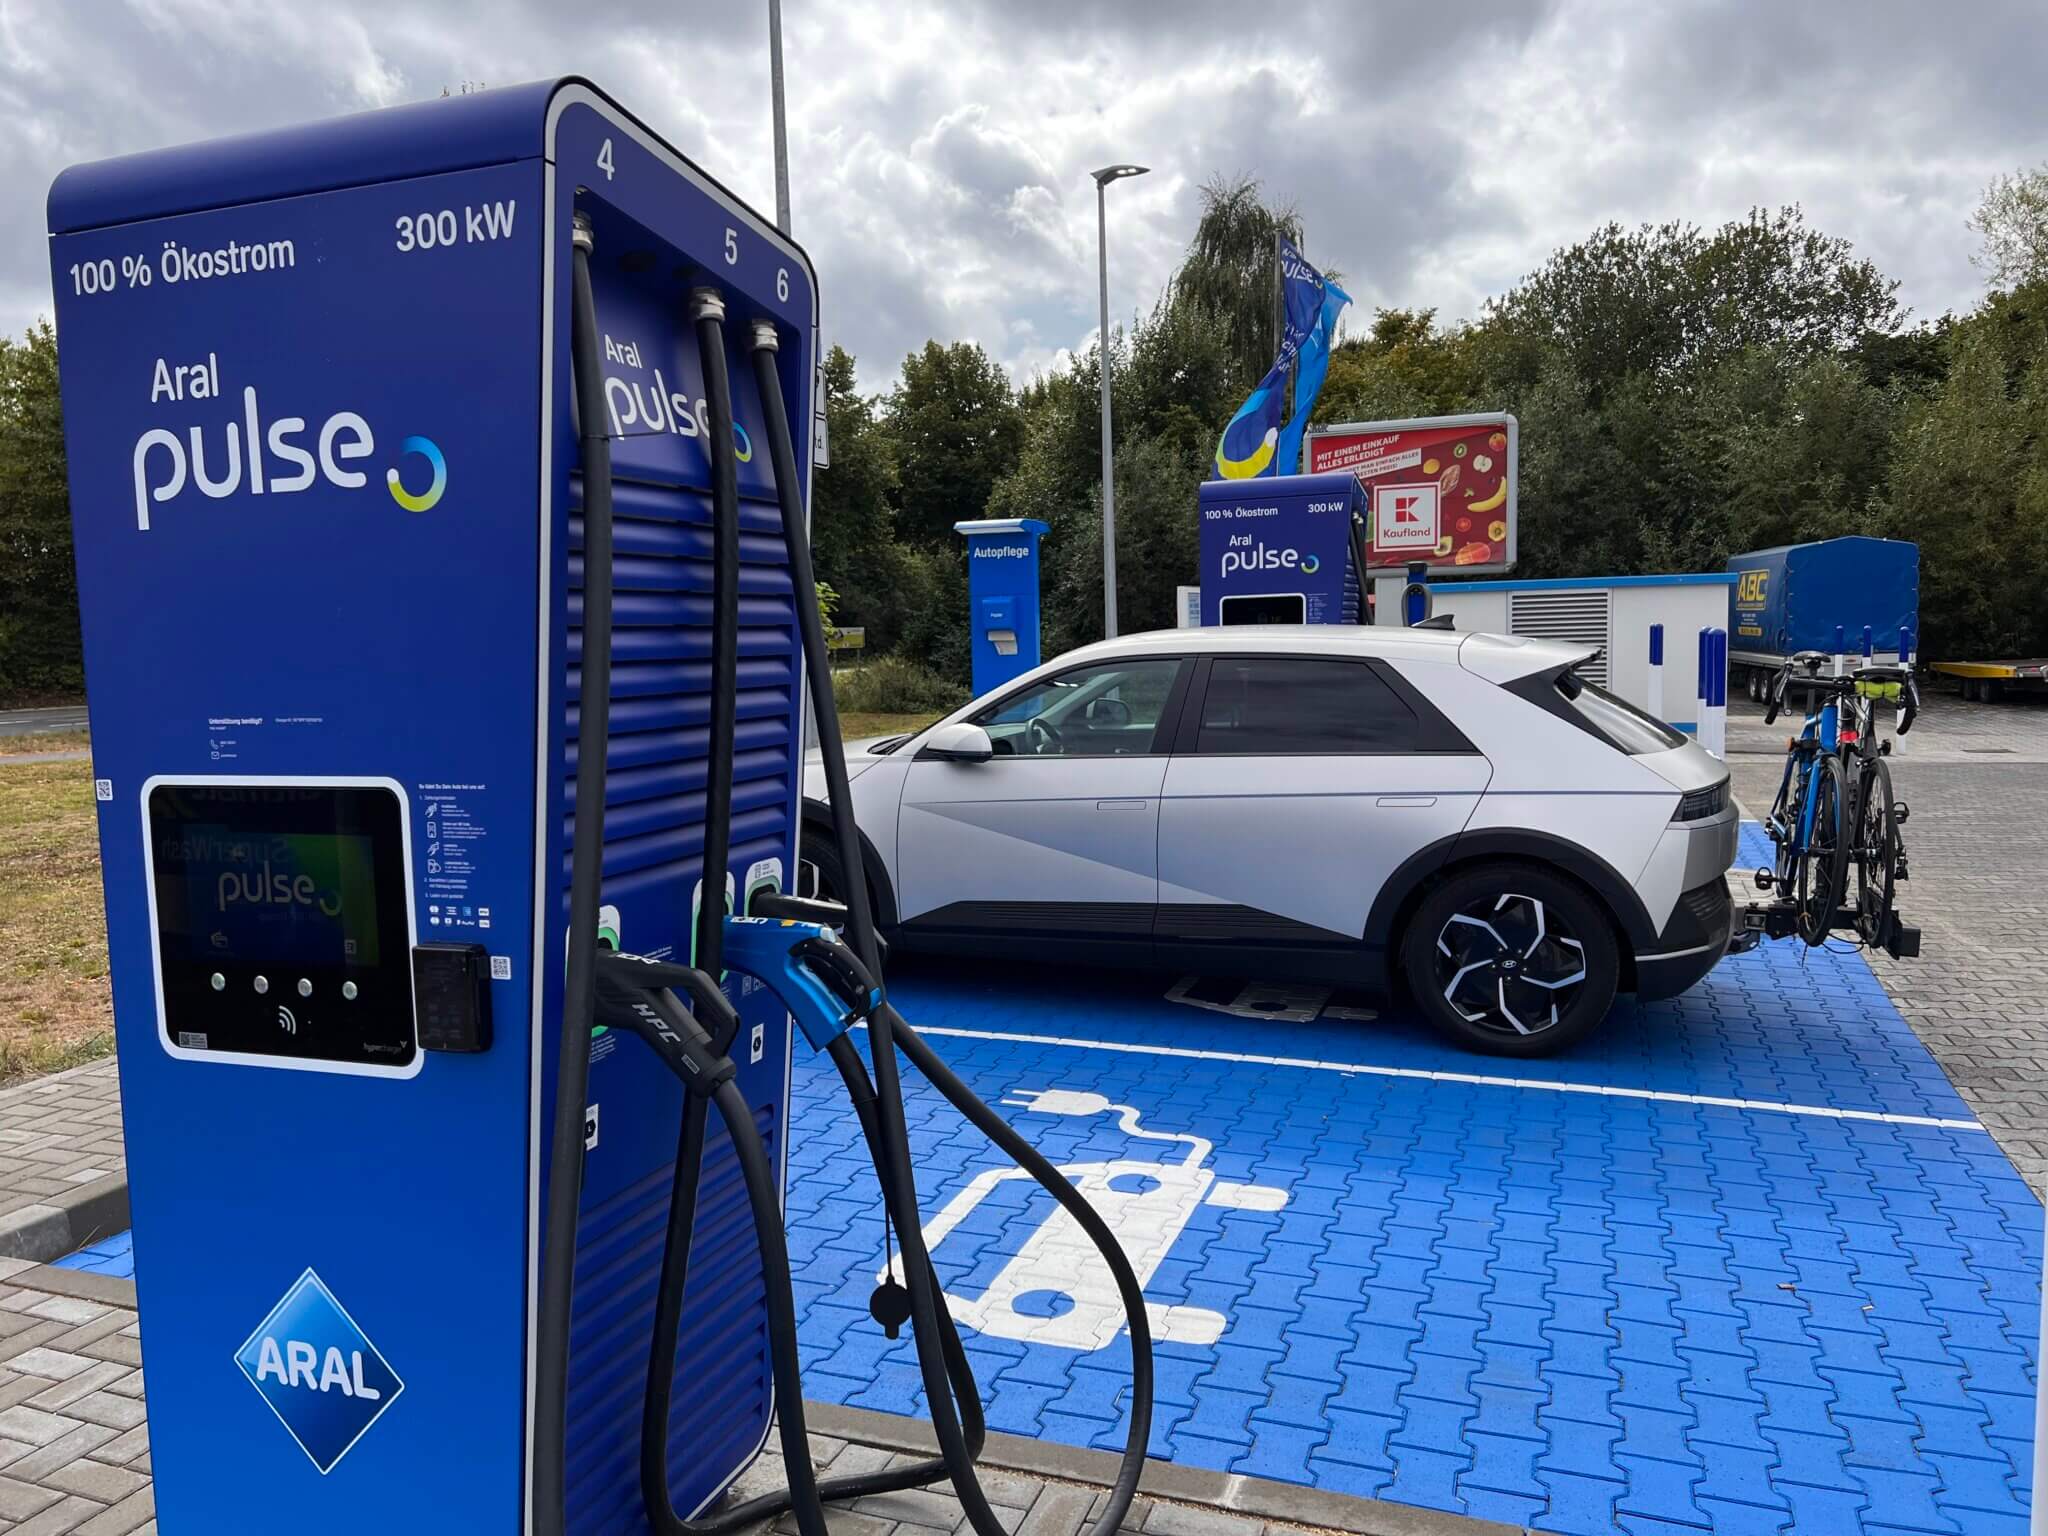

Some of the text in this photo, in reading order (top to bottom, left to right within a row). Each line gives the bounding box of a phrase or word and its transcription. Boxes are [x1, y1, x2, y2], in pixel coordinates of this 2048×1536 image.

[596, 138, 615, 181] 4
[395, 199, 516, 252] 300 kW
[724, 227, 738, 265] 5
[70, 239, 295, 295] 100 % Ökostrom
[776, 268, 789, 303] 6
[605, 334, 643, 369] Aral
[152, 352, 219, 403] Aral
[133, 386, 374, 531] pulse
[1316, 434, 1400, 463] MIT EINEM EINKAUF
[1317, 447, 1385, 471] ALLES ERLEDIGT
[1205, 506, 1278, 520] 100 % Ökostrom
[1308, 502, 1344, 513] 300 kW
[1229, 534, 1252, 547] Aral
[1383, 527, 1431, 539] Kaufland
[974, 546, 1029, 559] Autopflege
[1221, 542, 1298, 578] pulse
[1738, 573, 1768, 601] ABC
[218, 860, 315, 912] pulse
[632, 1004, 681, 1043] HPC
[256, 1336, 380, 1400] ARAL
